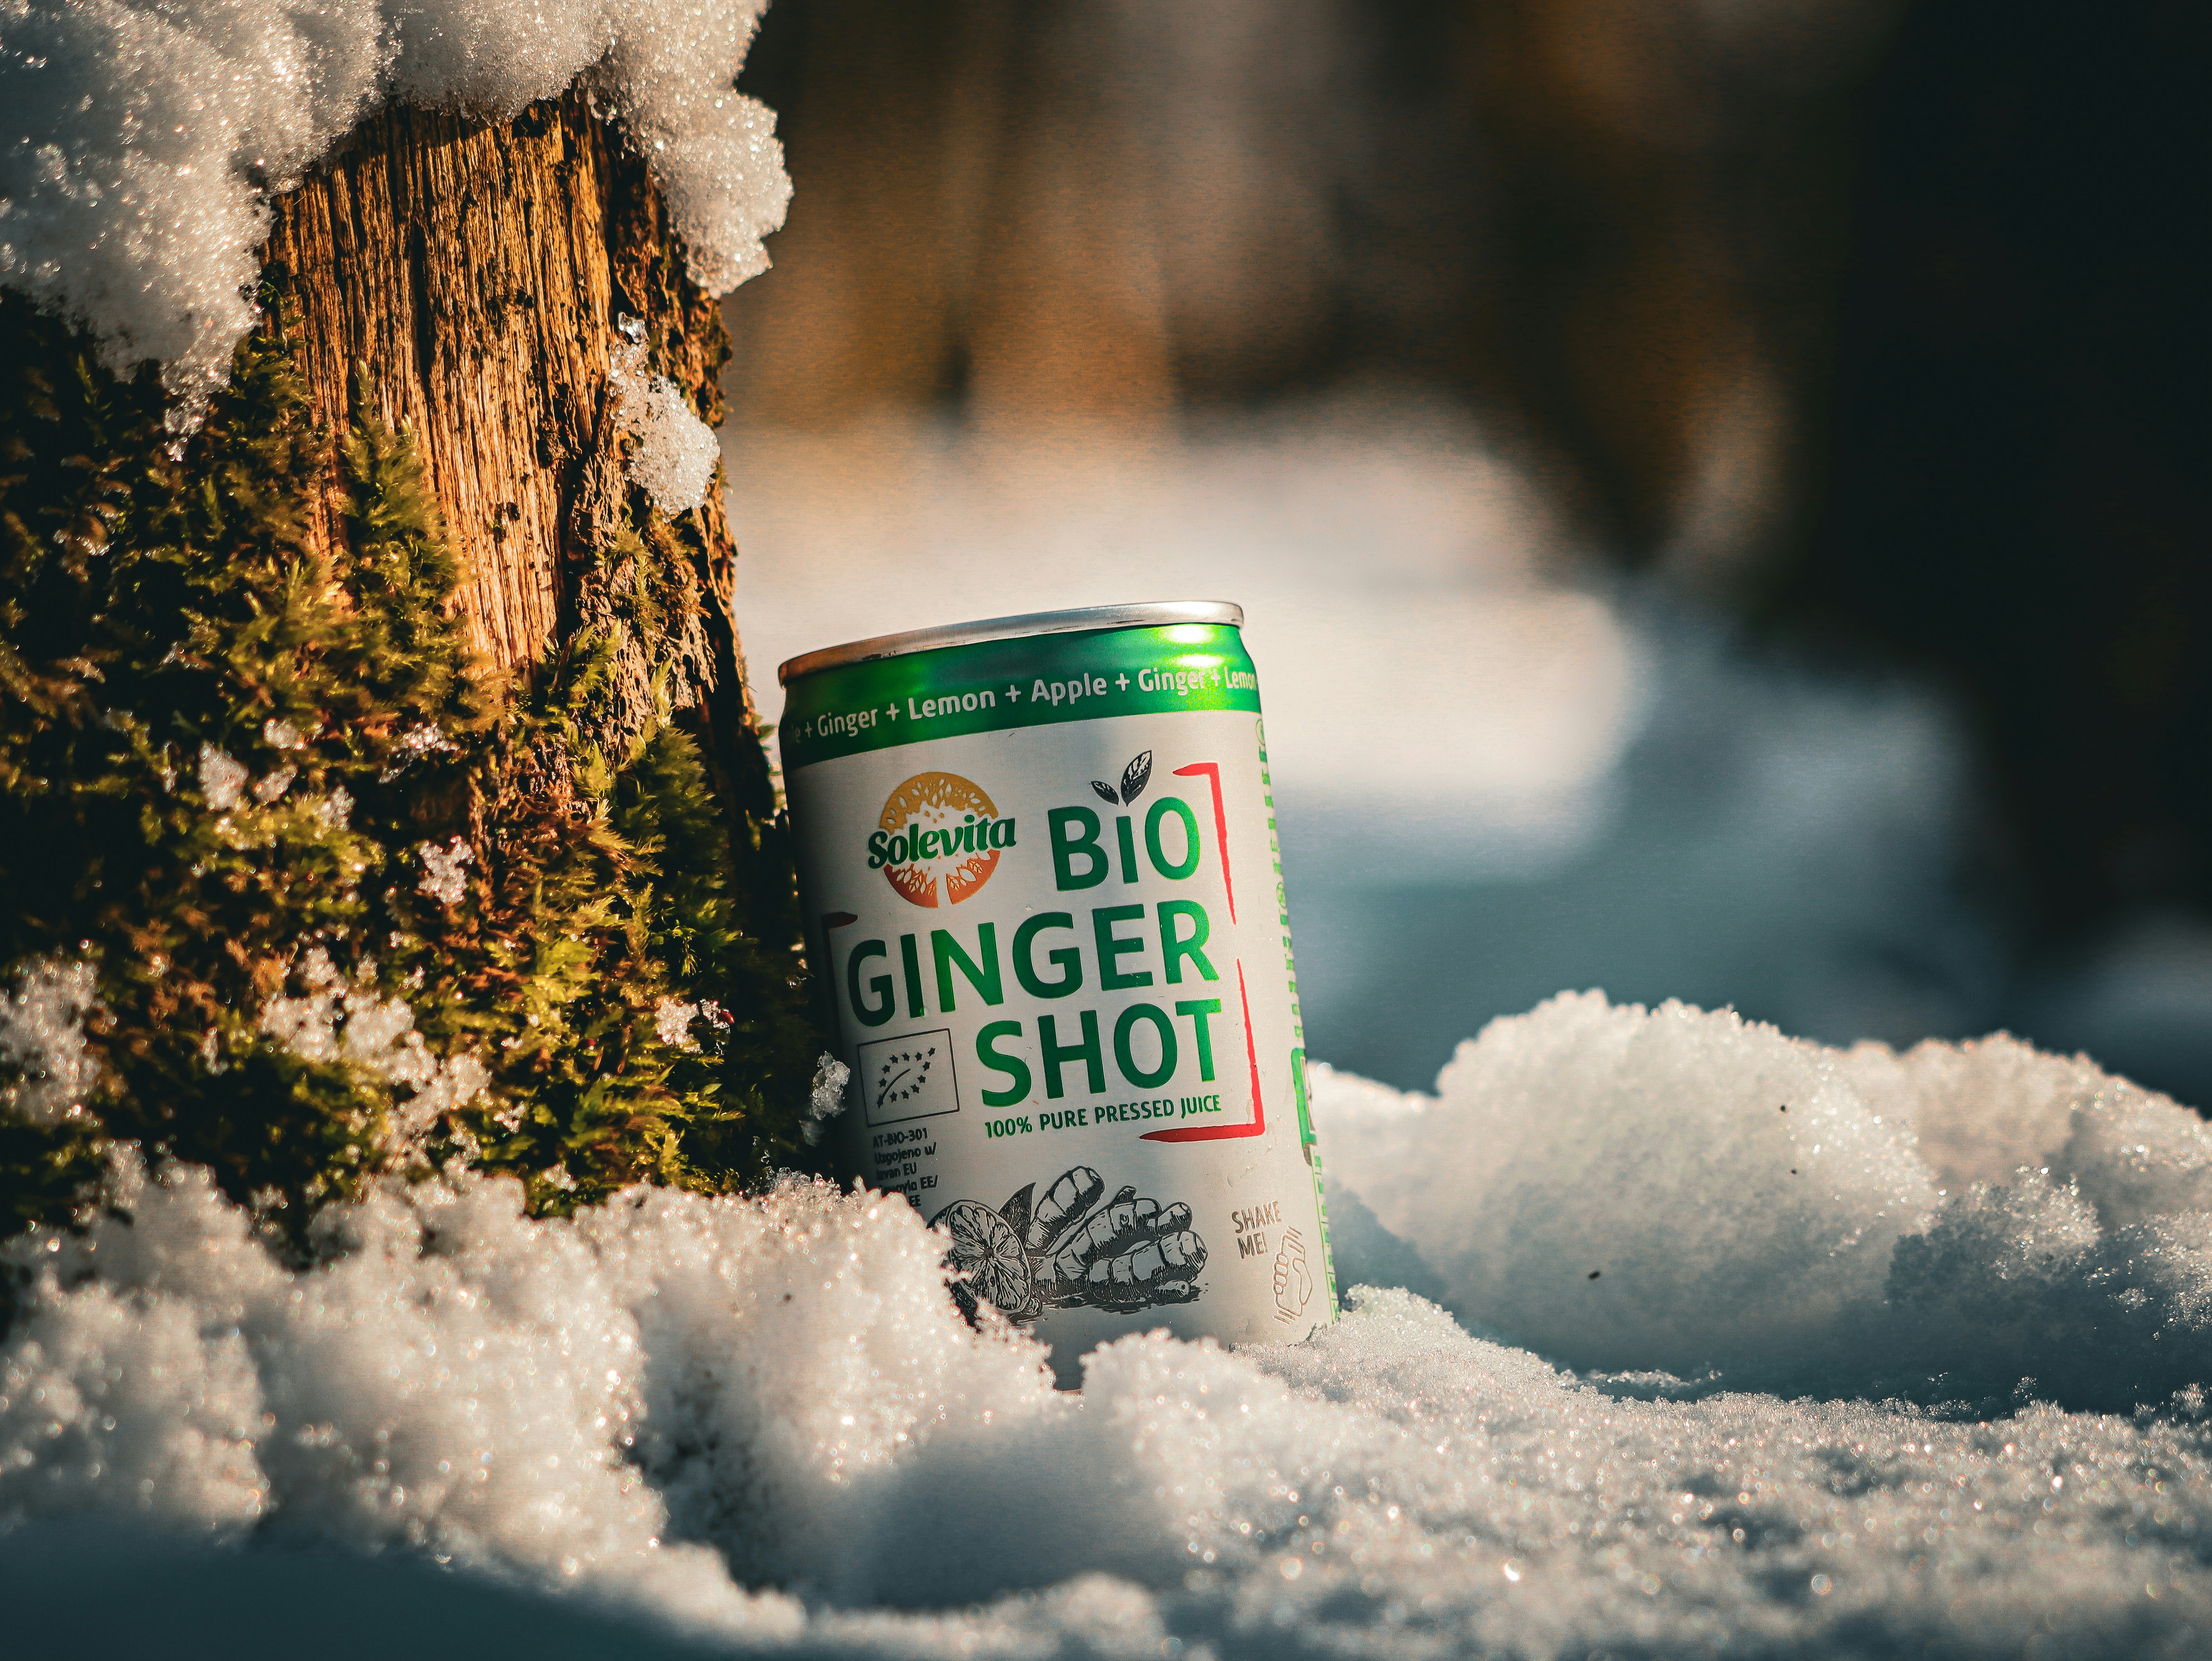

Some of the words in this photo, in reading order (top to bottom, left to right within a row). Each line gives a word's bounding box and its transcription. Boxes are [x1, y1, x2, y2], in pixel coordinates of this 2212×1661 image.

[817, 708, 878, 737] Ginger
[908, 690, 996, 720] Lemon
[1031, 672, 1107, 706] Apple
[1138, 667, 1205, 696] Ginger
[868, 814, 1017, 870] Solevita
[847, 899, 1220, 1027] GINGER
[976, 998, 1222, 1107] SHOT
[873, 1127, 928, 1149] AT-BIO-301
[984, 1115, 1033, 1139] 100%
[1039, 1108, 1088, 1131] PURE
[1094, 1099, 1174, 1124] PRESSED
[1181, 1094, 1222, 1119] JUICE
[903, 1161, 918, 1176] EU
[1232, 1200, 1282, 1234] SHAKE
[1237, 1232, 1268, 1259] ME!
